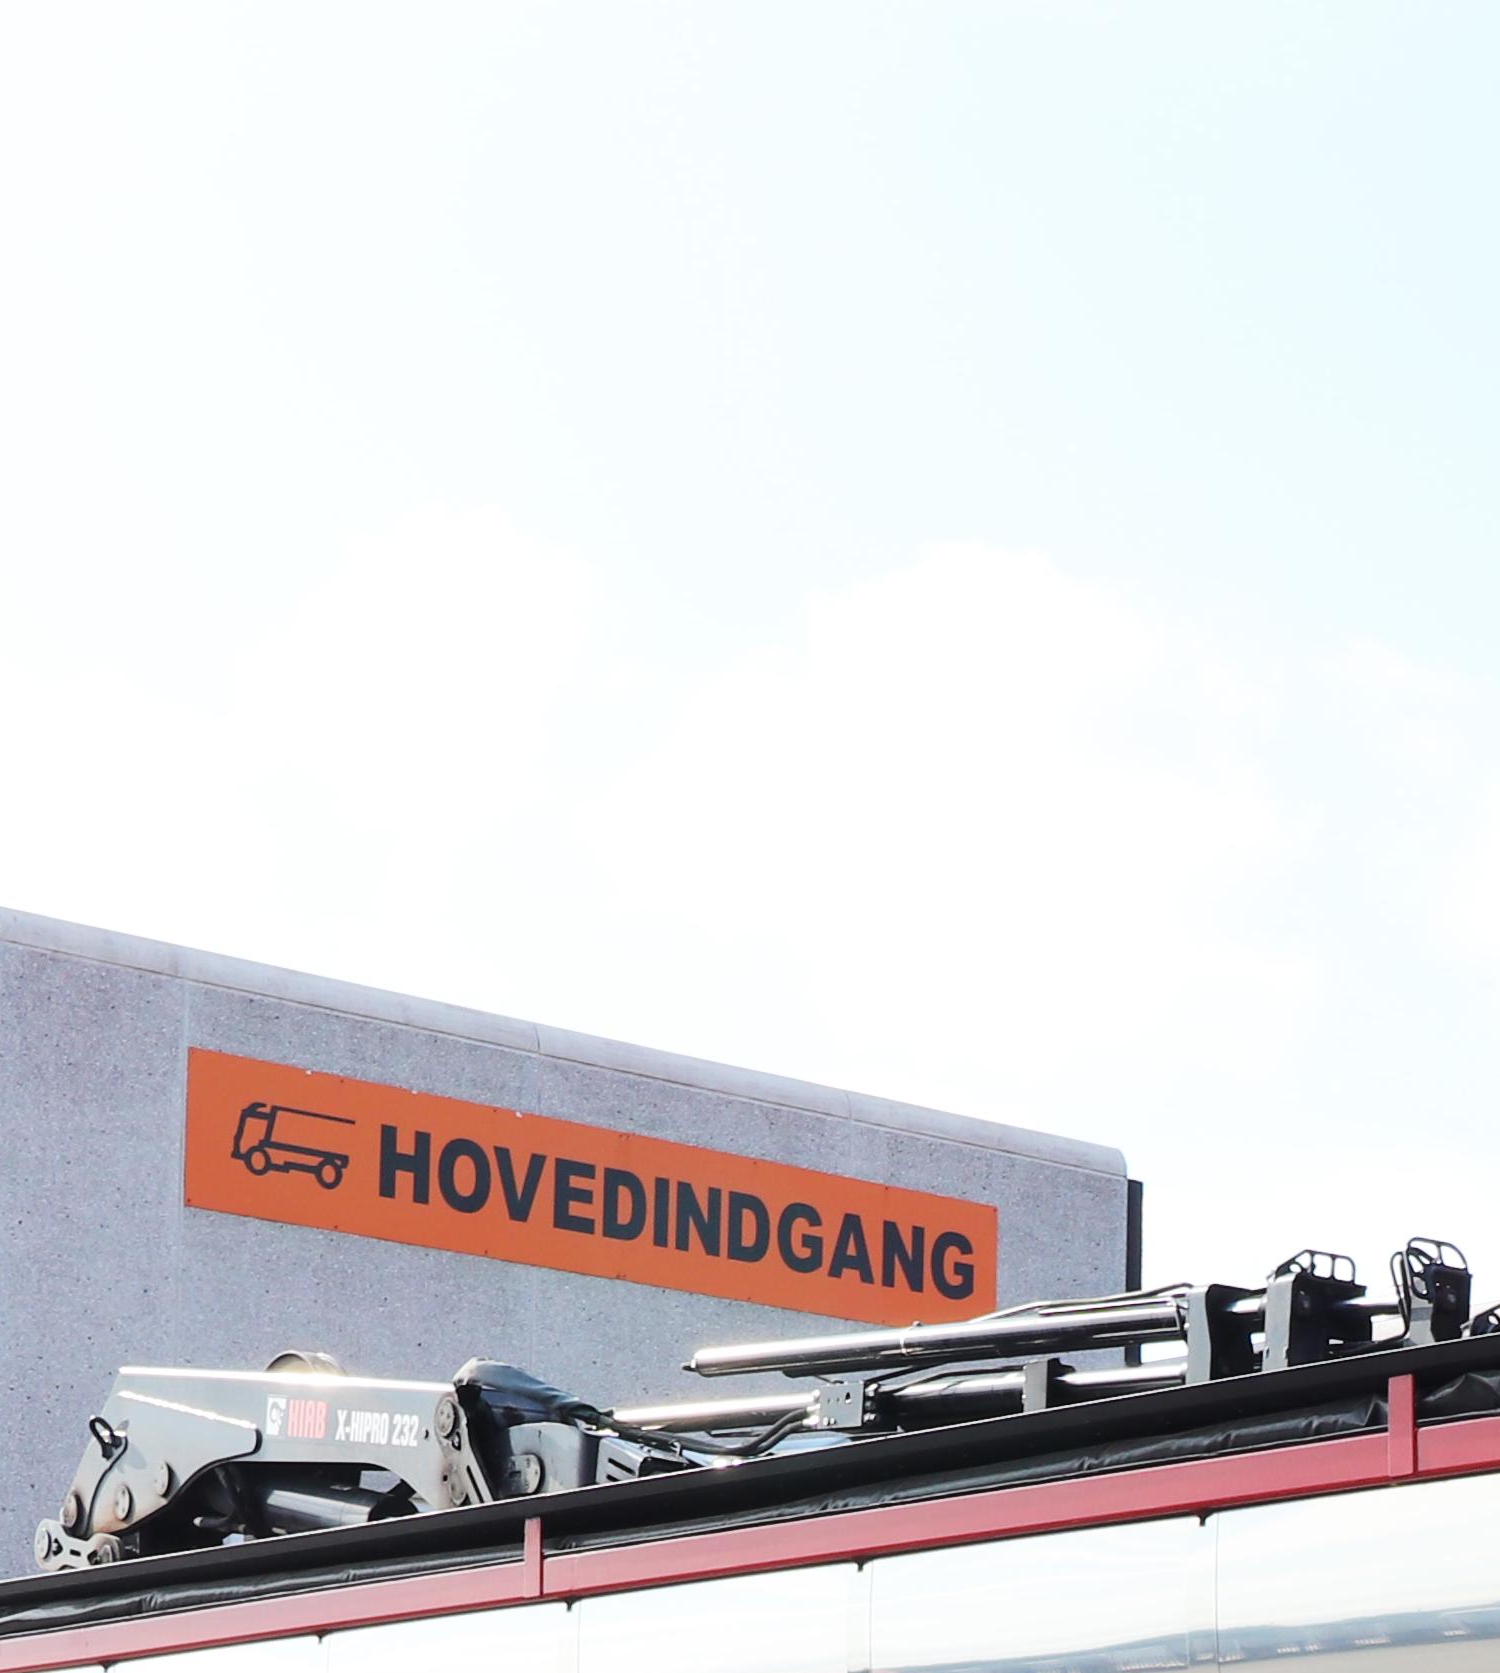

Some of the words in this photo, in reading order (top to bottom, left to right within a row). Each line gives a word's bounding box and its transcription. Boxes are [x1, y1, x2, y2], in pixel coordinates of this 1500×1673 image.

[379, 1124, 976, 1300] HOVEDINDGANG
[287, 1399, 329, 1439] HIAB
[335, 1410, 390, 1446] X-HIPRO
[391, 1413, 419, 1448] 232
